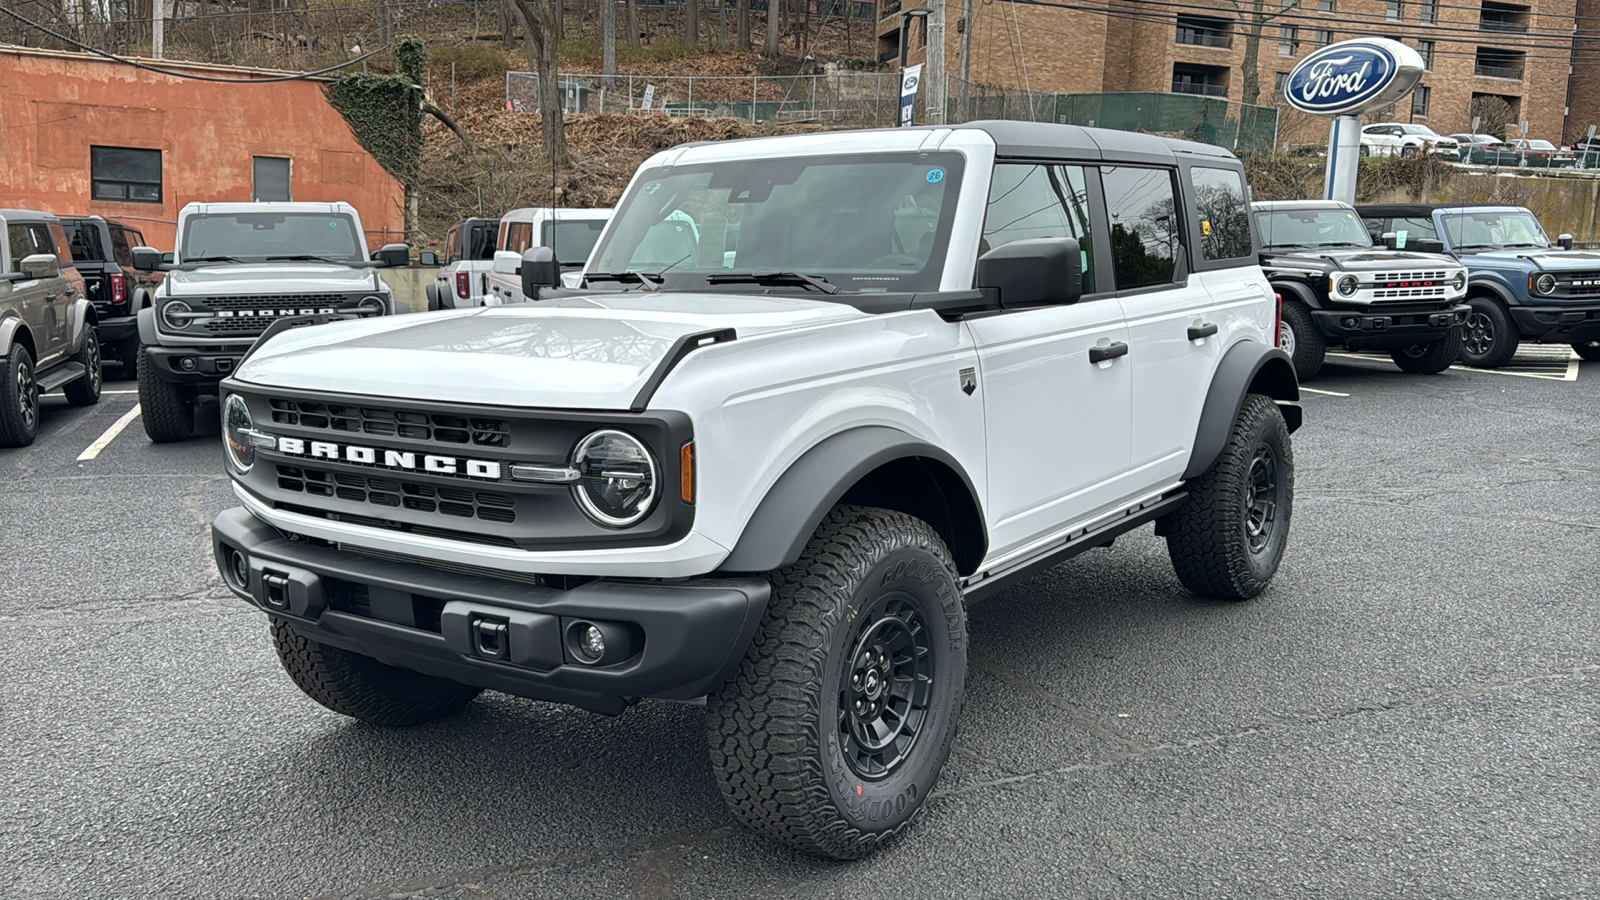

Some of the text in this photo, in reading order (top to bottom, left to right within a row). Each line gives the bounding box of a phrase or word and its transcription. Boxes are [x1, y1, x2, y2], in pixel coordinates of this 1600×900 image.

[1303, 55, 1370, 101] Ford
[928, 170, 943, 181] 26
[218, 308, 334, 318] BRONCO
[279, 437, 500, 479] BRONCO
[880, 557, 962, 652] GOODYEAR
